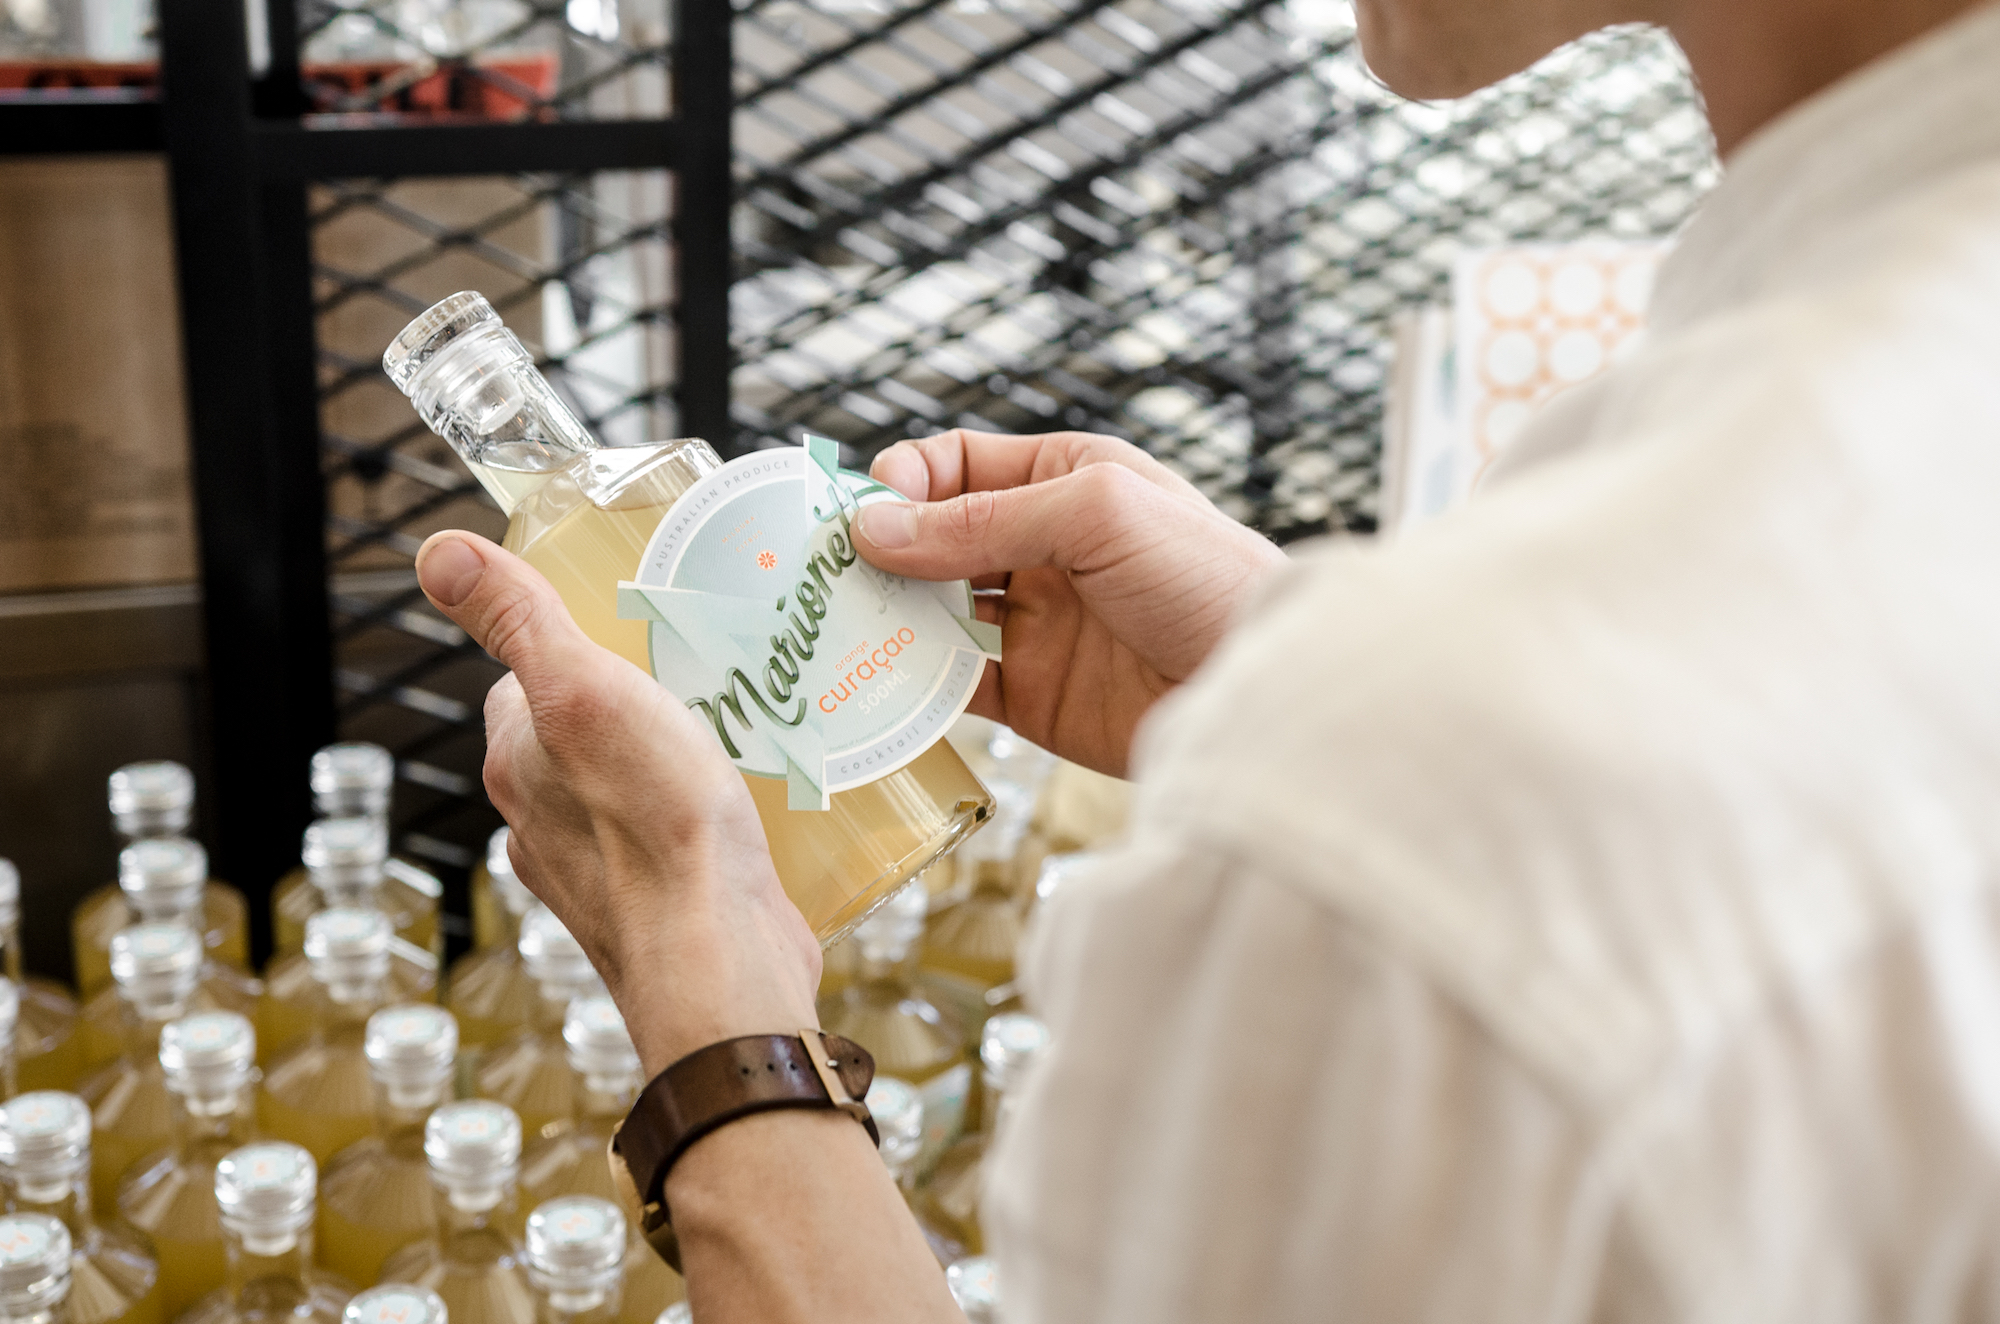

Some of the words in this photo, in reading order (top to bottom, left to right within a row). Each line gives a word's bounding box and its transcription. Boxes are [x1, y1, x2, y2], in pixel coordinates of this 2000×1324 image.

[655, 488, 718, 570] AUSTRALIAN
[723, 460, 791, 489] PRODUCE
[735, 529, 763, 553] CITRUS
[818, 627, 915, 714] curaçao
[835, 639, 870, 672] orange
[840, 725, 920, 774] cocktail
[926, 661, 968, 722] staples
[857, 668, 911, 715] 500ML
